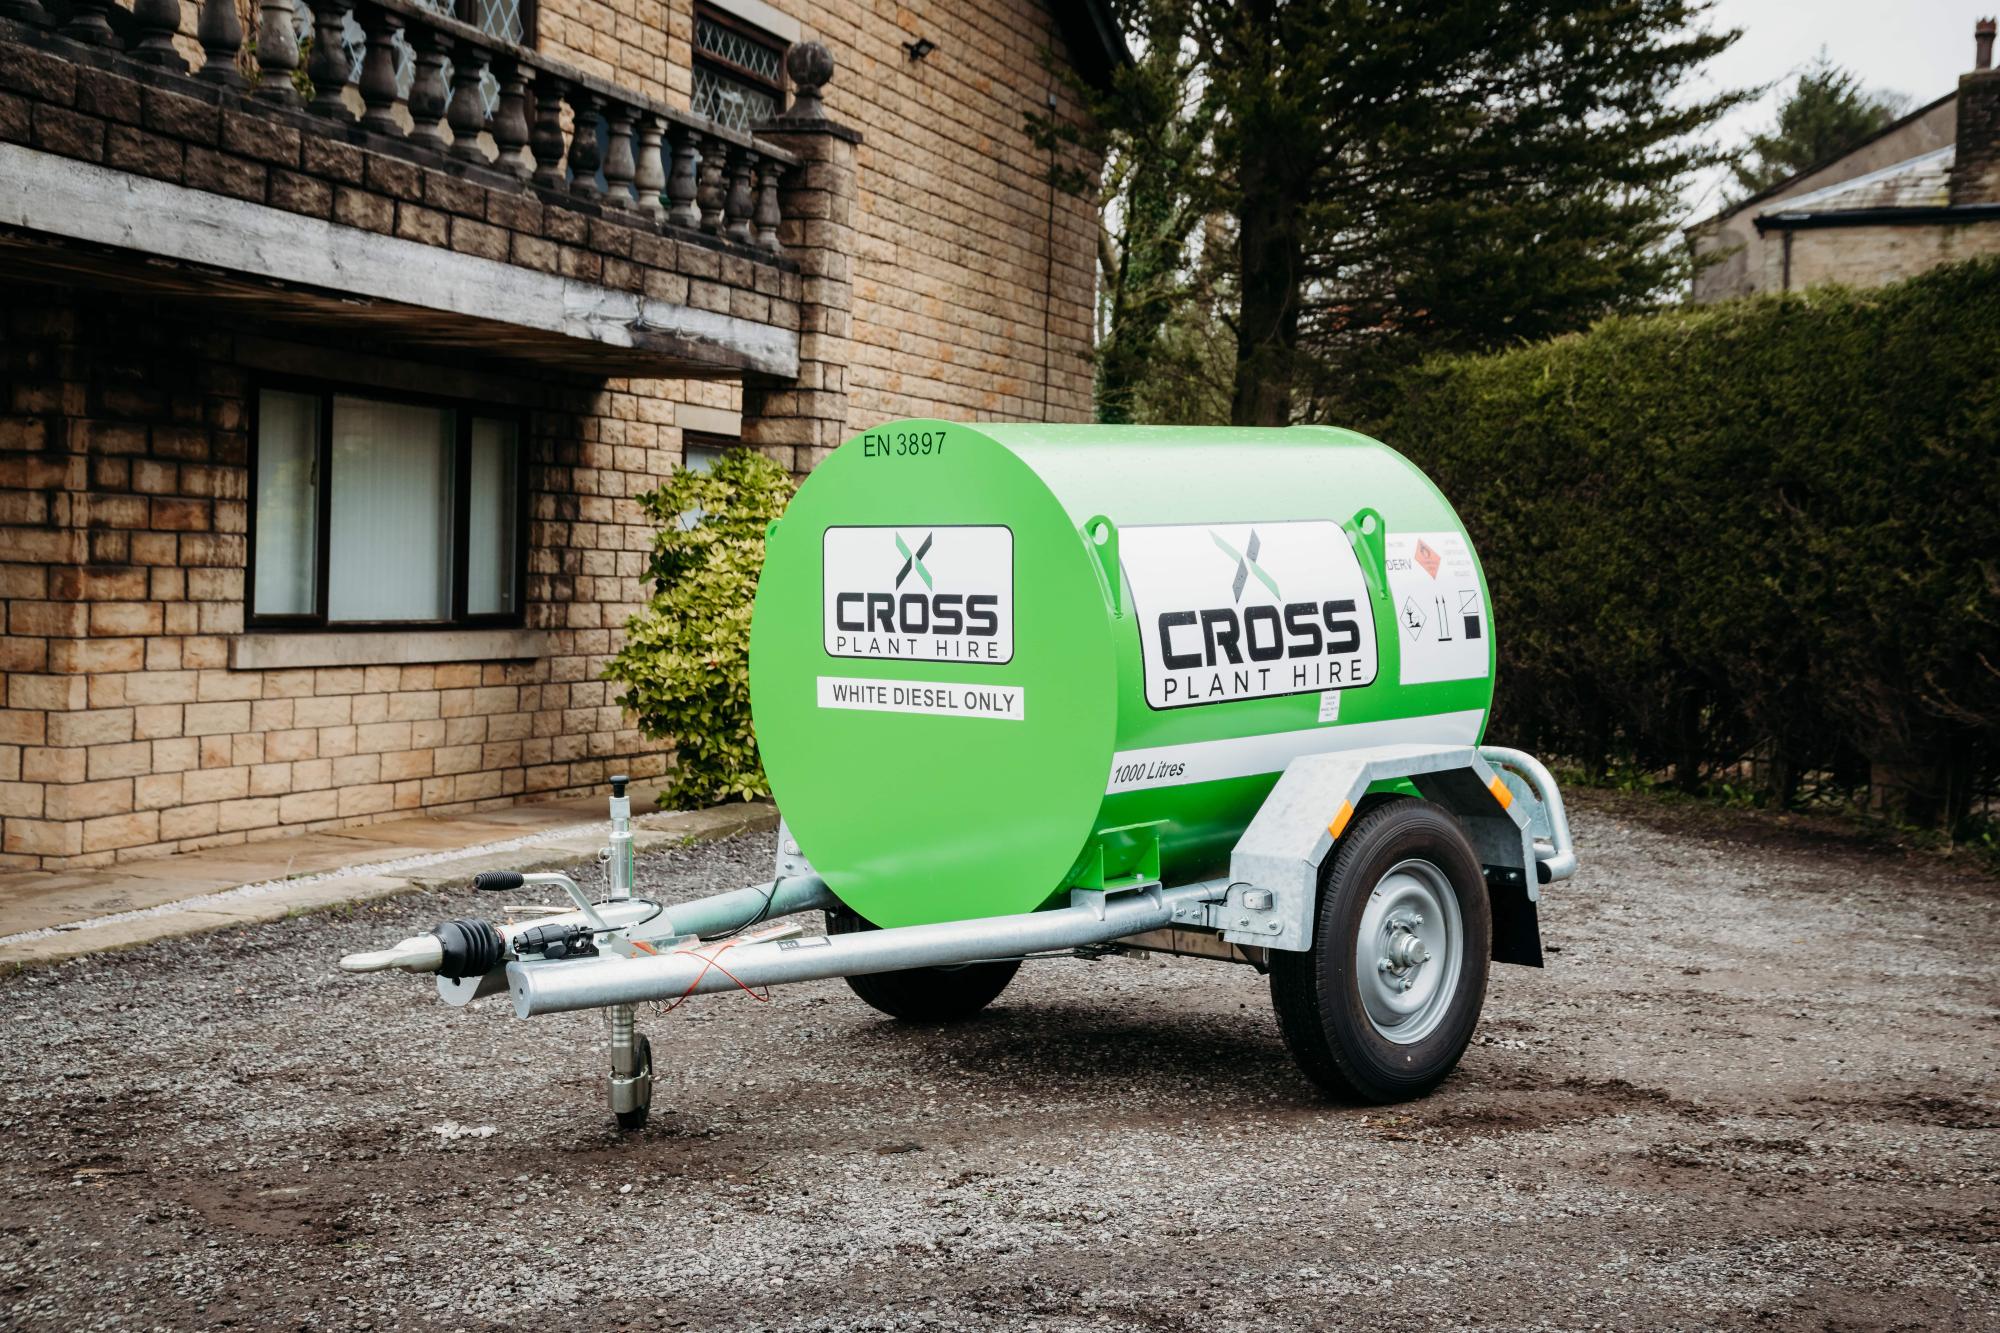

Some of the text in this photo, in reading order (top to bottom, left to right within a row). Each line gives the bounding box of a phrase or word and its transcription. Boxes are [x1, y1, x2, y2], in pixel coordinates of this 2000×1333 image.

[863, 432, 947, 457] EN 3897
[836, 592, 998, 636] CROSS
[837, 636, 998, 658] PLANT HIRE
[1158, 599, 1360, 670] CROSS
[1164, 659, 1361, 702] PLANT HIRE
[833, 684, 1014, 712] WHITE DIESEL ONLY
[1114, 760, 1185, 784] 1000 Litres
